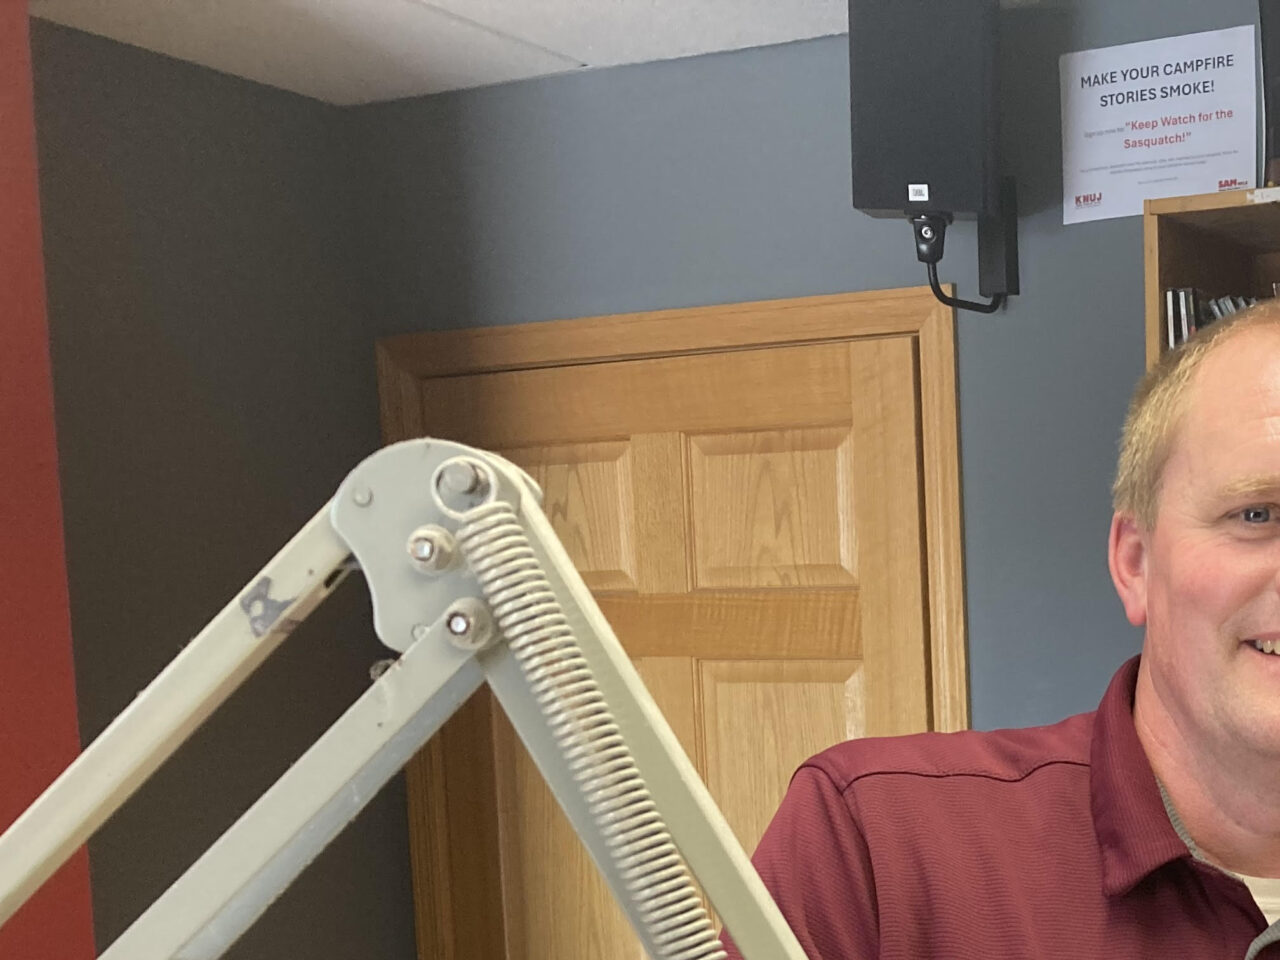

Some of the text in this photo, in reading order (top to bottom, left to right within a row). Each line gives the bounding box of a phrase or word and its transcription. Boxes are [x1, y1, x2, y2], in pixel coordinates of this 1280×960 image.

[1080, 54, 1235, 89] MAKE YOUR CAMPFIRE
[1099, 80, 1215, 108] STORIES SMOKE!
[1160, 114, 1196, 127] Watch
[1198, 111, 1213, 123] for
[1215, 109, 1234, 120] the
[1123, 132, 1192, 149] Sasquatch!”
[1075, 192, 1102, 205] KNUJ
